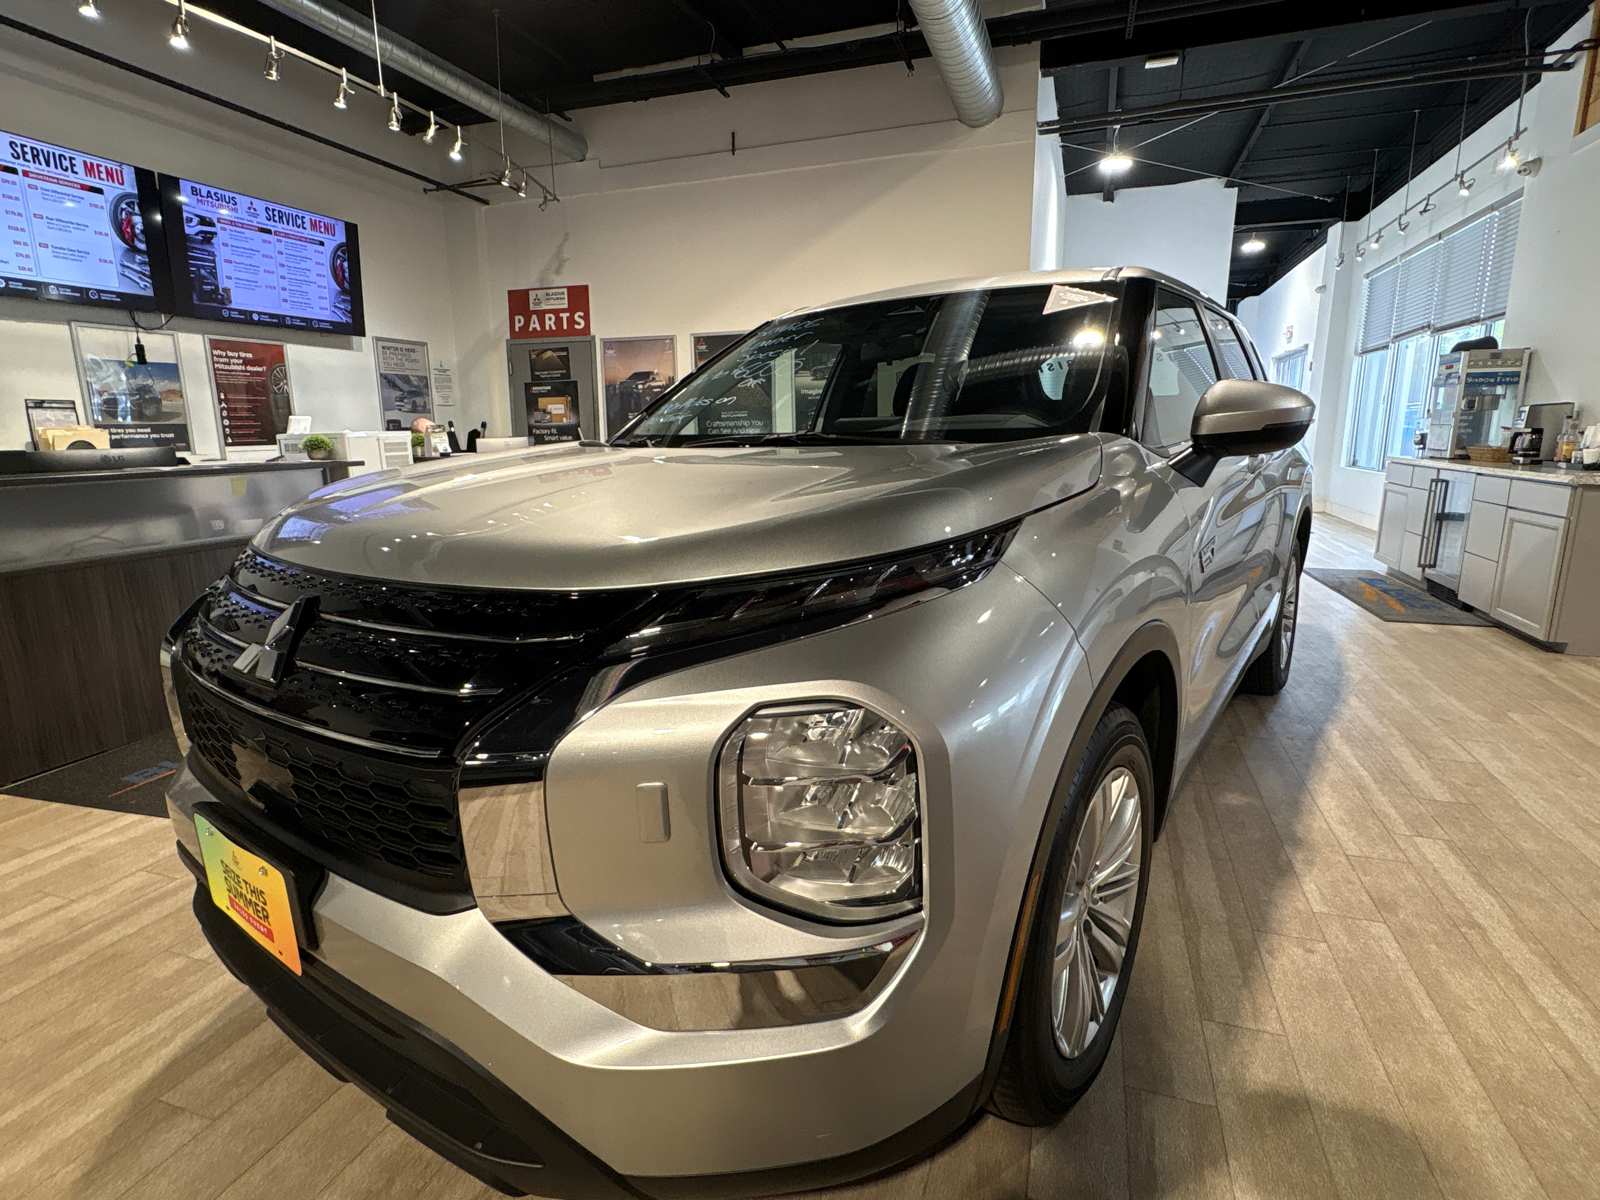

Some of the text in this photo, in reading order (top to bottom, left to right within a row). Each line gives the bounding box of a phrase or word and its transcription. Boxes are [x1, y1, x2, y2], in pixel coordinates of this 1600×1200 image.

[9, 140, 125, 186] SERVICE MENU
[190, 185, 238, 206] BLASIUS
[196, 198, 239, 214] MITSUBISHI
[264, 206, 307, 230] SERVICE
[310, 217, 336, 237] MENU
[514, 311, 586, 333] PARTS
[212, 349, 227, 357] Why
[226, 350, 239, 358] buy
[214, 363, 245, 371] Mitsubishi
[706, 420, 751, 428] Craftsmanship
[732, 427, 745, 435] And
[220, 859, 243, 891] SEIZE
[242, 879, 268, 906] THIS
[223, 875, 272, 927] SUMMER
[233, 901, 268, 935] SALES EVENT
